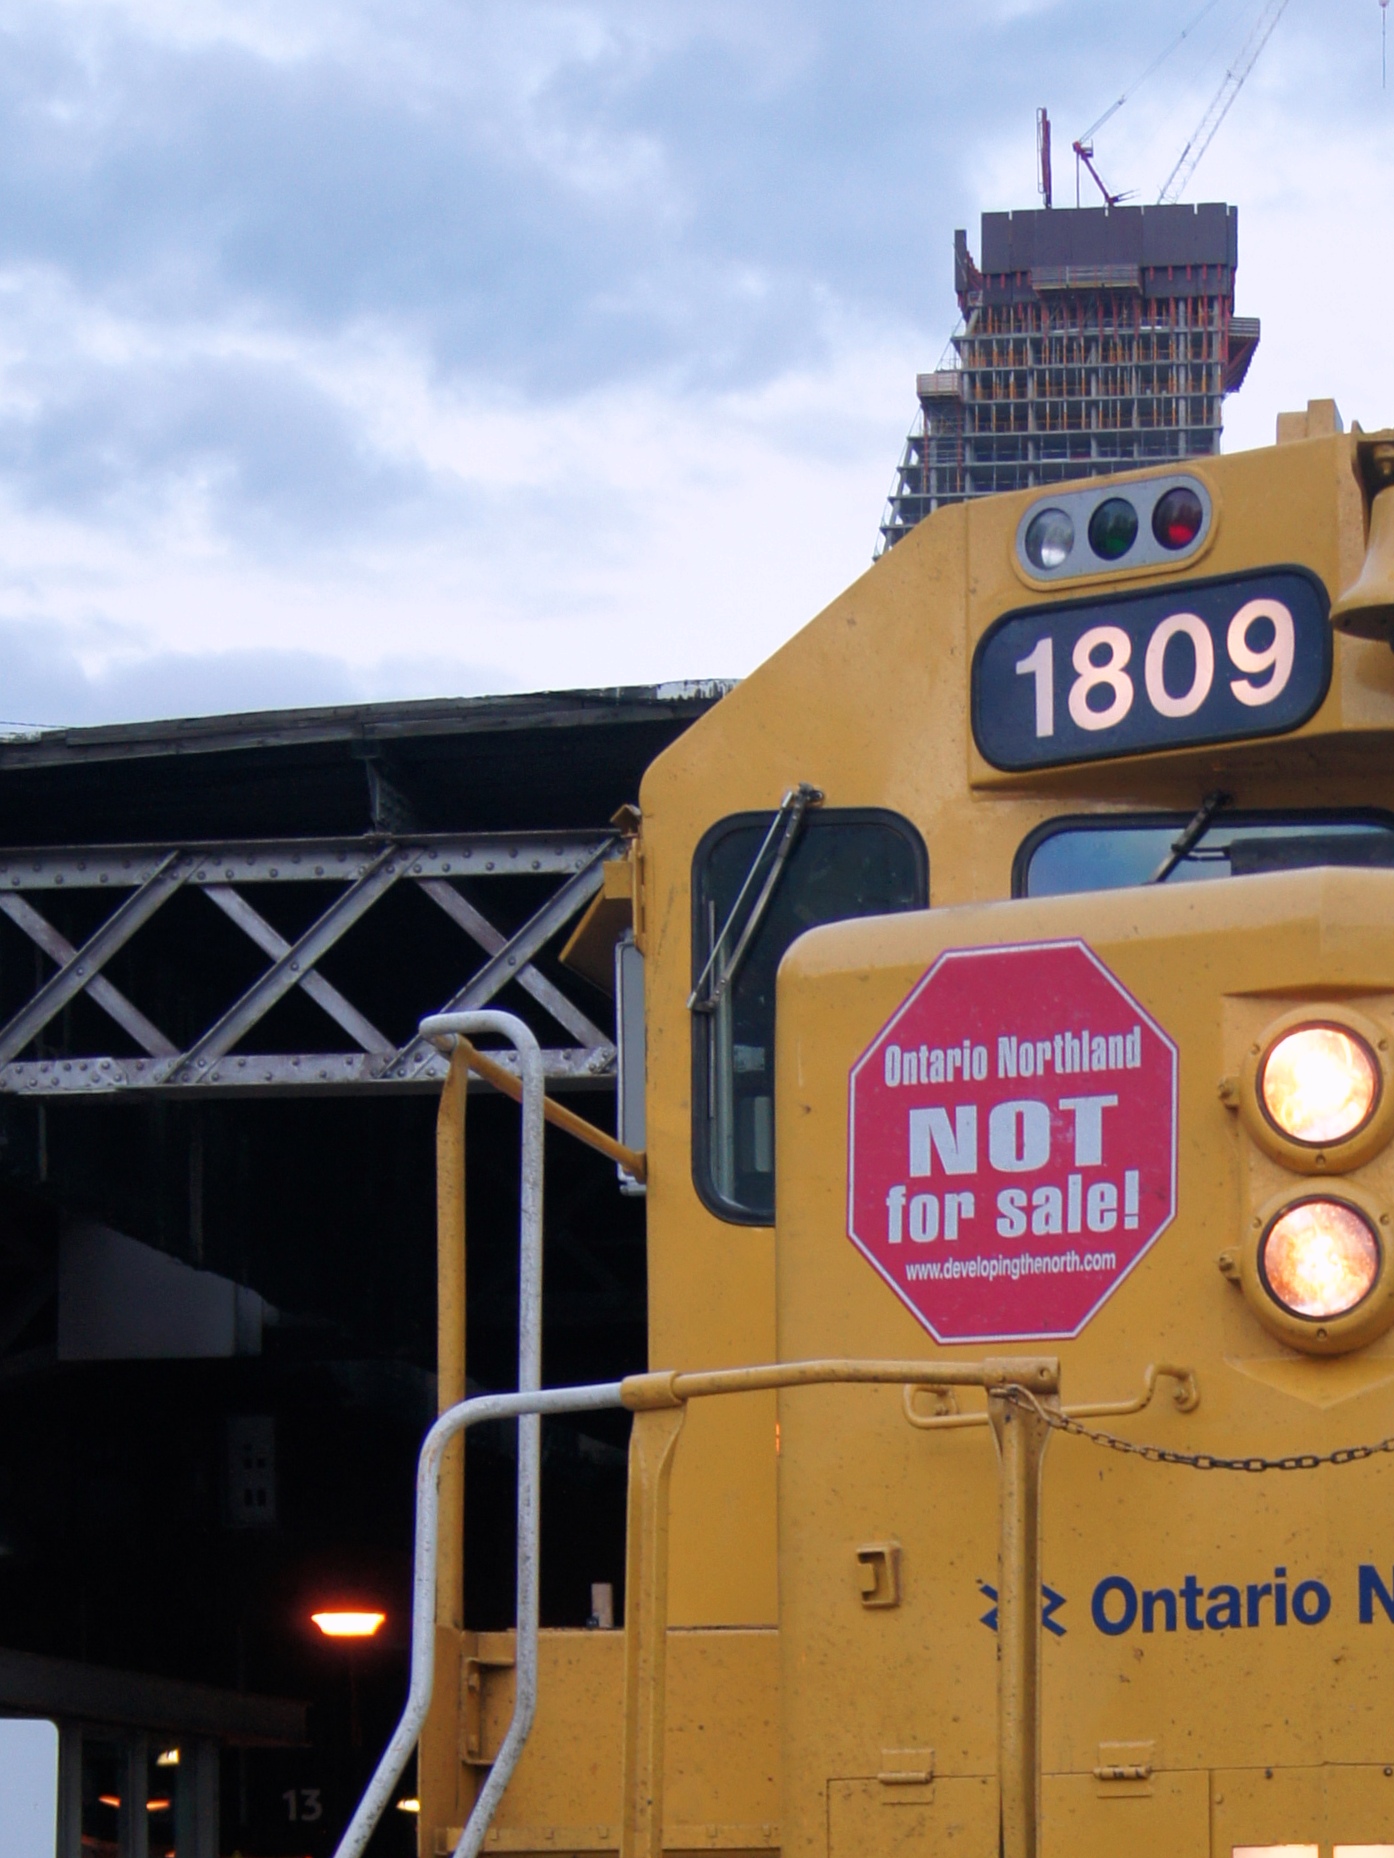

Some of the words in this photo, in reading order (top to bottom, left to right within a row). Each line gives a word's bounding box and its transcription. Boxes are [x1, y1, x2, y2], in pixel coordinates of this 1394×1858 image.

[1015, 598, 1295, 738] 1809
[884, 1039, 988, 1088] Ontario
[997, 1025, 1142, 1079] Northland
[908, 1094, 1119, 1178] NOT
[885, 1184, 976, 1245] for
[996, 1168, 1140, 1238] sale!
[904, 1249, 1117, 1282] www.developingthenorth.com
[1090, 1567, 1332, 1637] Ontario
[281, 1787, 324, 1822] 13
